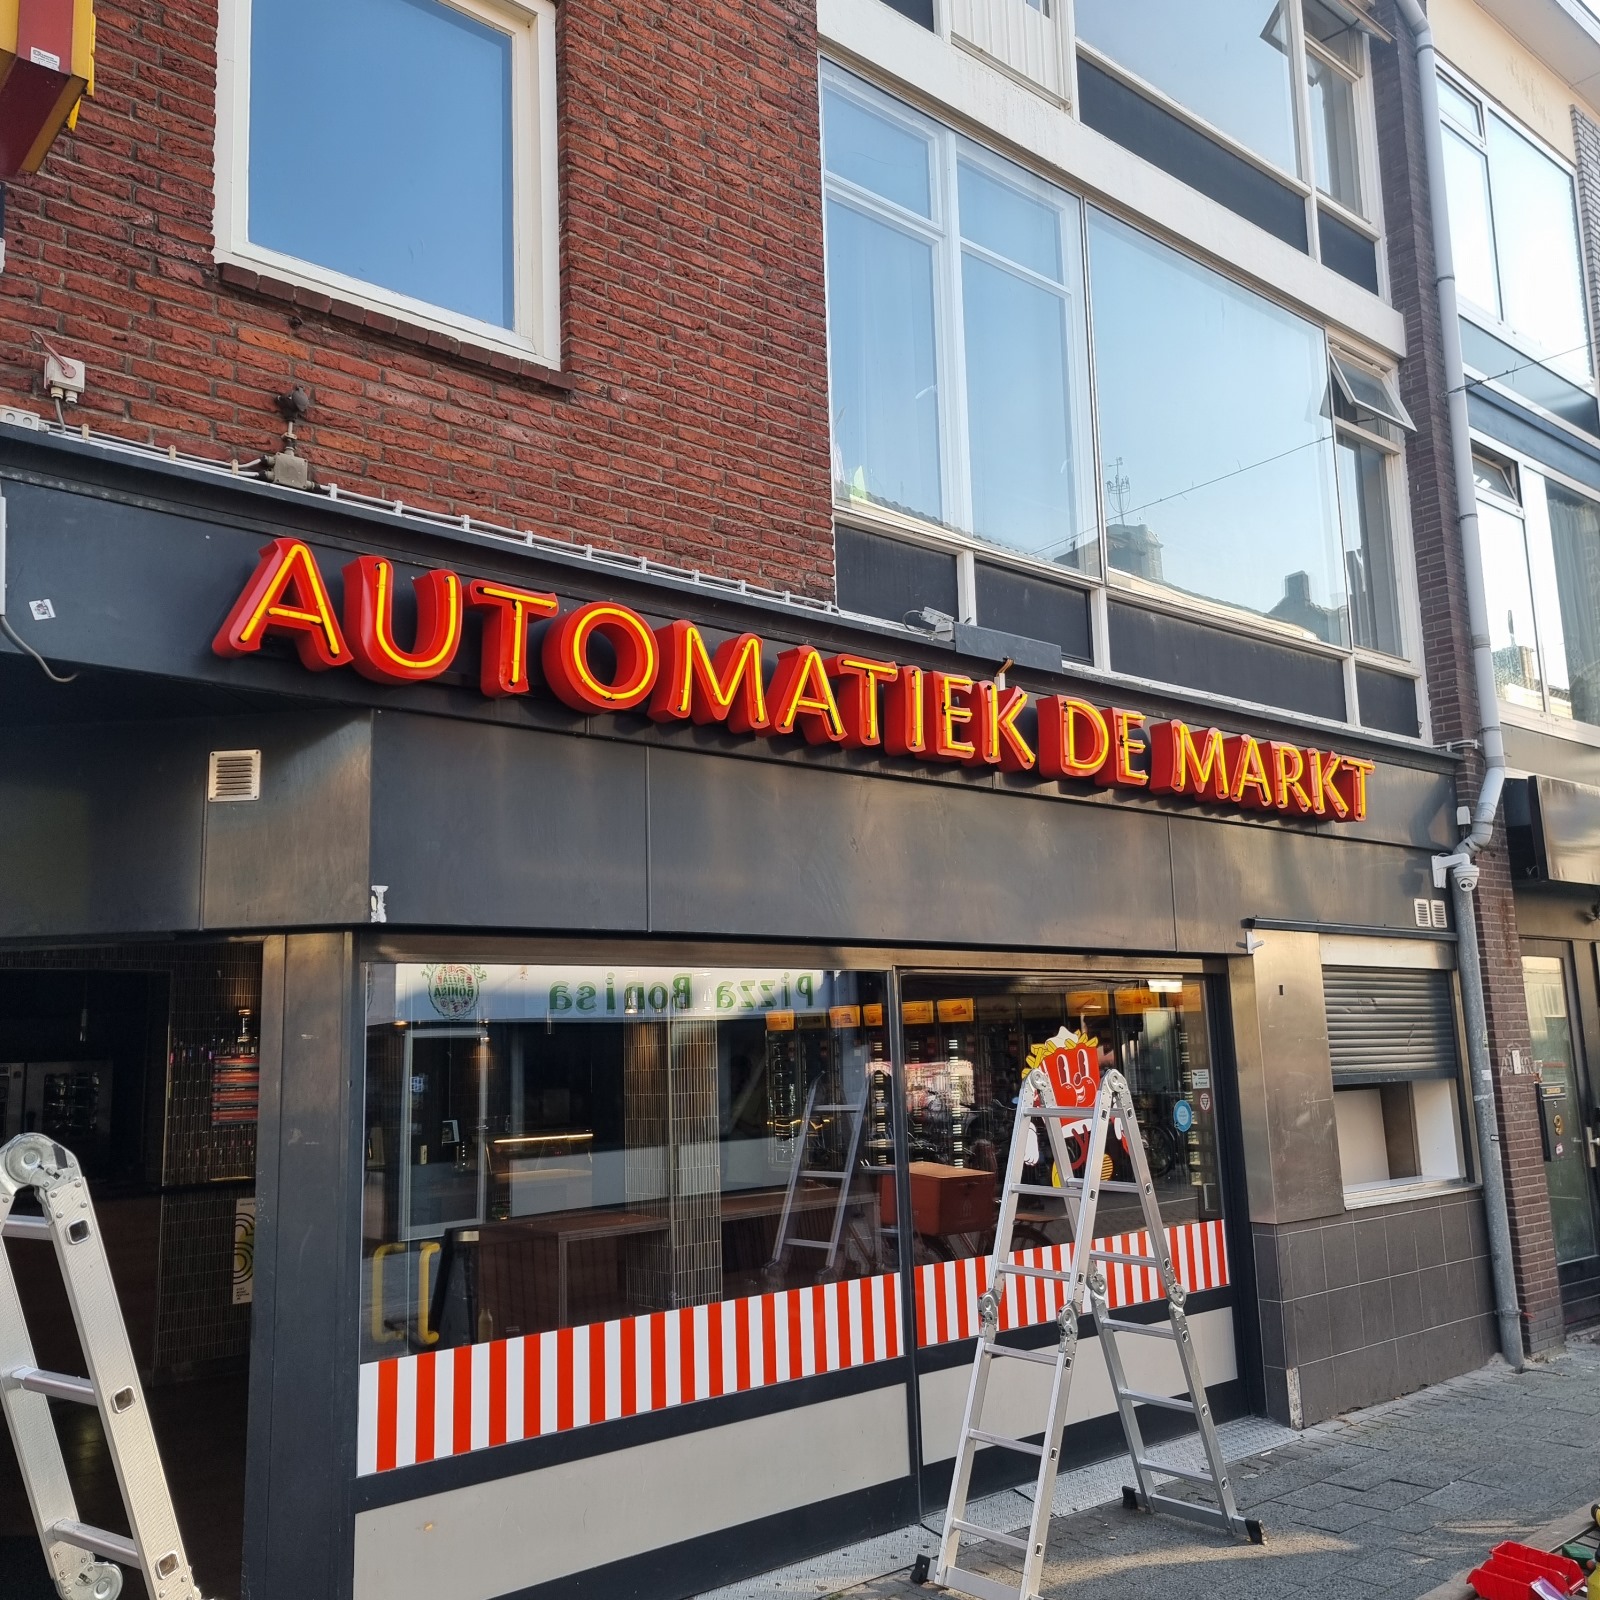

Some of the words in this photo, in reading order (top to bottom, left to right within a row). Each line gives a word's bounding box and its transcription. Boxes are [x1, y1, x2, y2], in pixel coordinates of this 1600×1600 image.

[212, 537, 1036, 773] AUTOMATIEK
[1037, 693, 1149, 789] DE
[1150, 719, 1375, 823] MARKT
